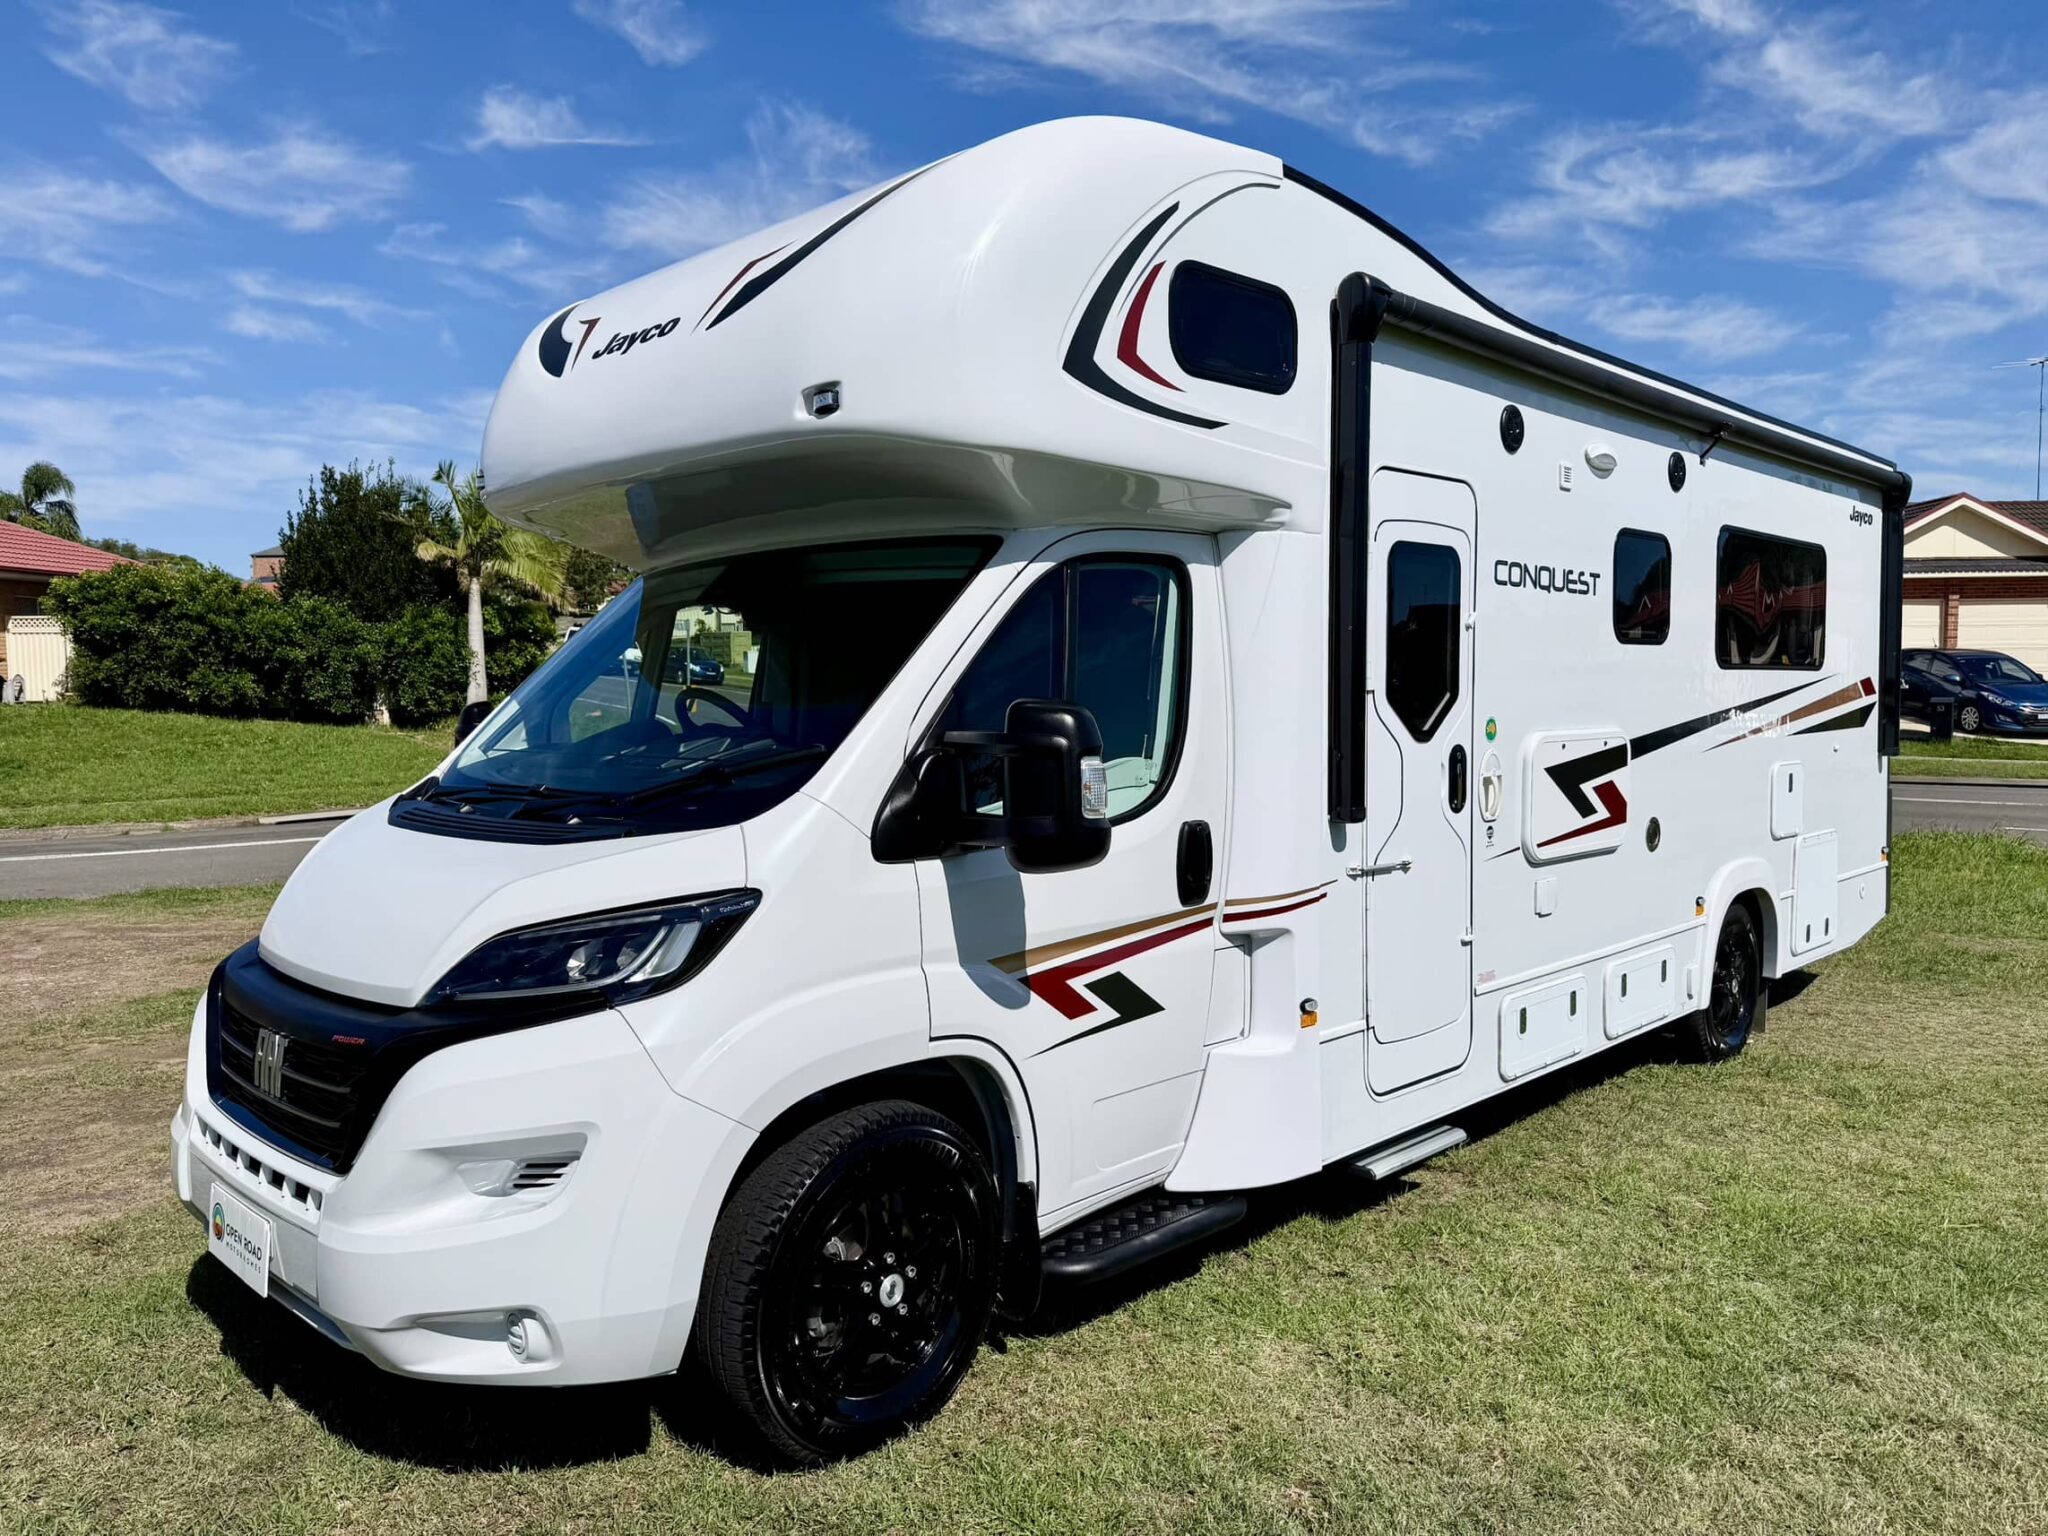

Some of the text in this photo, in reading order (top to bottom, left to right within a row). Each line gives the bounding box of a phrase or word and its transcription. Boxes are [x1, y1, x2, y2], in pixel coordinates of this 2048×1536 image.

[592, 316, 681, 360] Jayco
[1850, 505, 1873, 527] Jayco
[1494, 559, 1601, 596] CONQUEST
[331, 1034, 365, 1046] POWER
[254, 1027, 289, 1098] FIAT
[225, 1223, 263, 1261] OPEN ROAD
